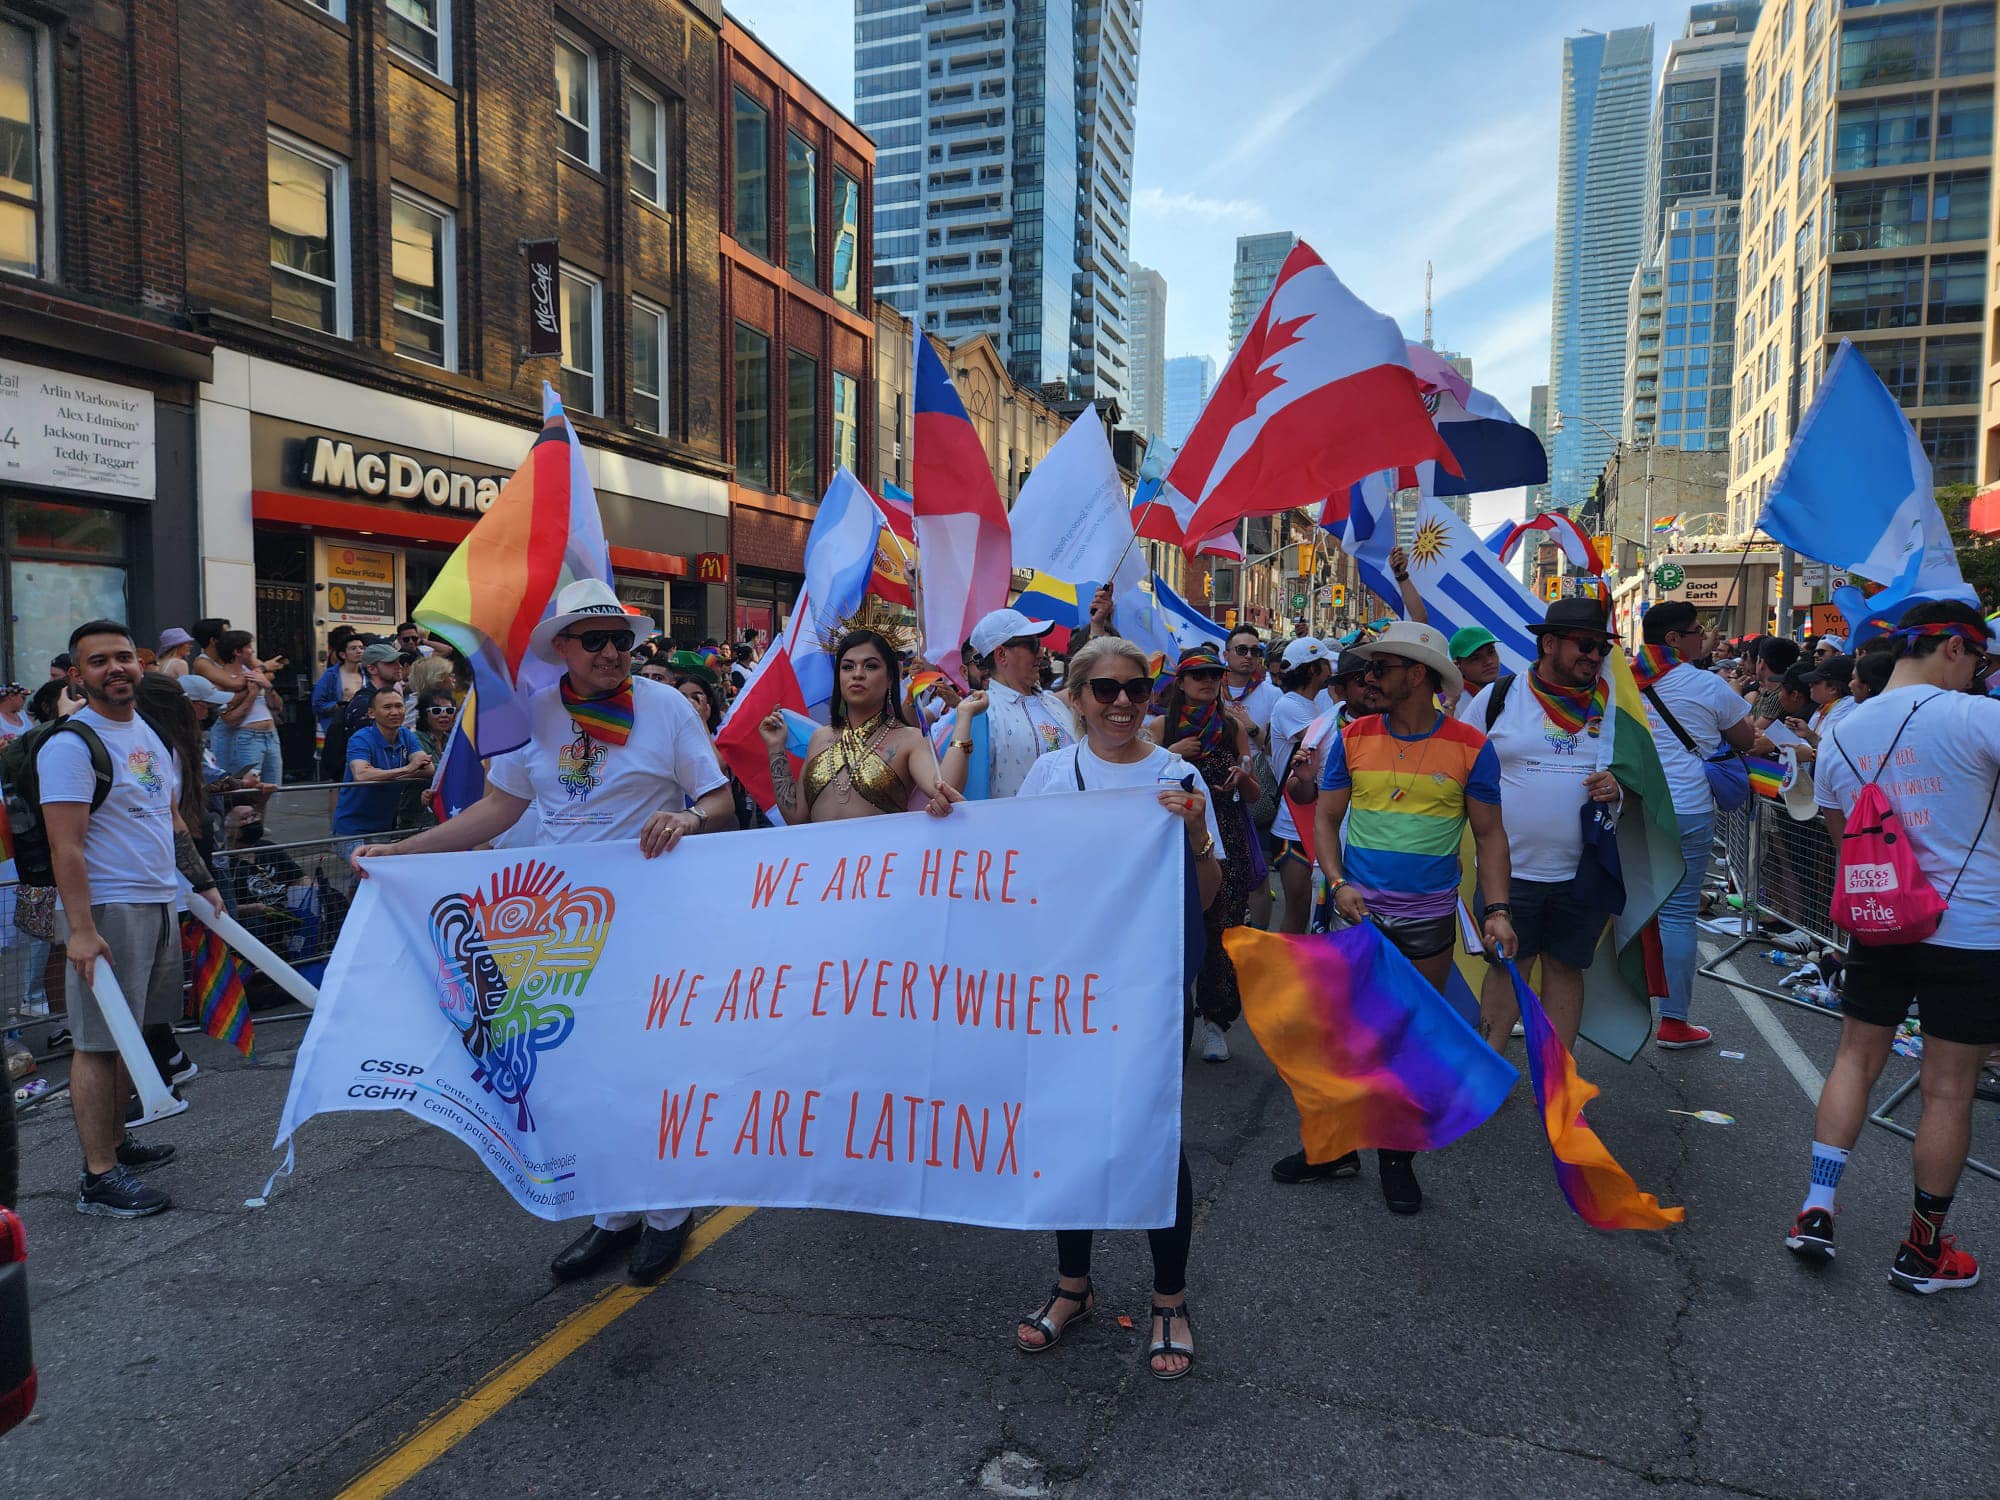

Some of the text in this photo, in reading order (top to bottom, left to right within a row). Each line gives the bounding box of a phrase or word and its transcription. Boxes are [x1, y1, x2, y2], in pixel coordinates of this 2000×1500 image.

[40, 383, 71, 399] Arlin
[57, 407, 84, 422] Alex
[43, 424, 90, 443] Jackson
[54, 447, 91, 465] Teddy
[311, 438, 510, 514] McDona
[1663, 569, 1676, 582] P
[1686, 581, 1718, 590] Good
[1686, 591, 1718, 599] Earth
[751, 849, 1038, 909] WE ARE HERE.
[1849, 879, 1889, 889] STORGE
[1851, 899, 1895, 921] Pride
[645, 958, 1120, 1036] WE ARE EVERYWHERE.
[360, 1059, 425, 1077] CSSP
[347, 1084, 418, 1101] CGHH
[436, 1078, 473, 1105] Centre
[475, 1102, 490, 1118] for
[658, 1084, 1042, 1179] WE ARE LATINX.
[423, 1098, 464, 1125] Centro
[464, 1121, 489, 1146] para
[487, 1144, 515, 1175] Gente
[515, 1172, 526, 1190] de
